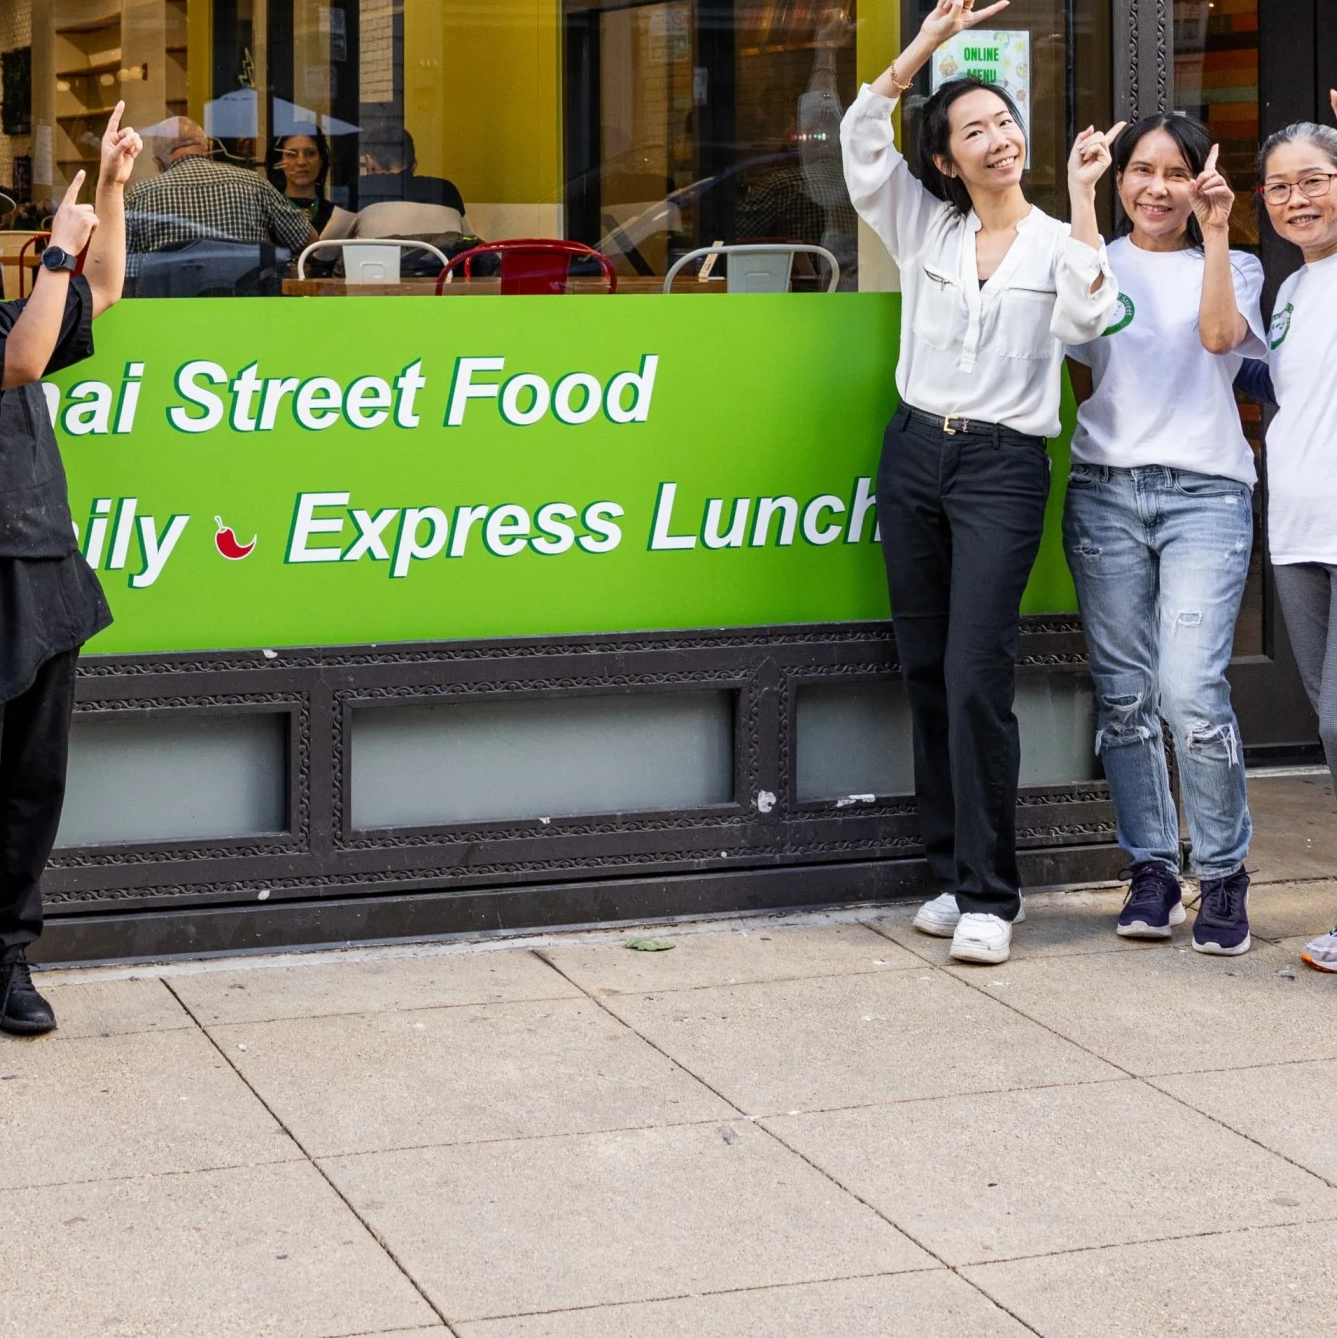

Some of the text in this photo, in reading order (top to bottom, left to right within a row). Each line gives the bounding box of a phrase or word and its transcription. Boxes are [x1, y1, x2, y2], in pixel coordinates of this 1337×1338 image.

[963, 46, 1000, 62] ONLINE
[165, 357, 426, 436] Street
[443, 353, 660, 428] Food
[283, 490, 625, 579] Express
[646, 475, 884, 552] Lunch
